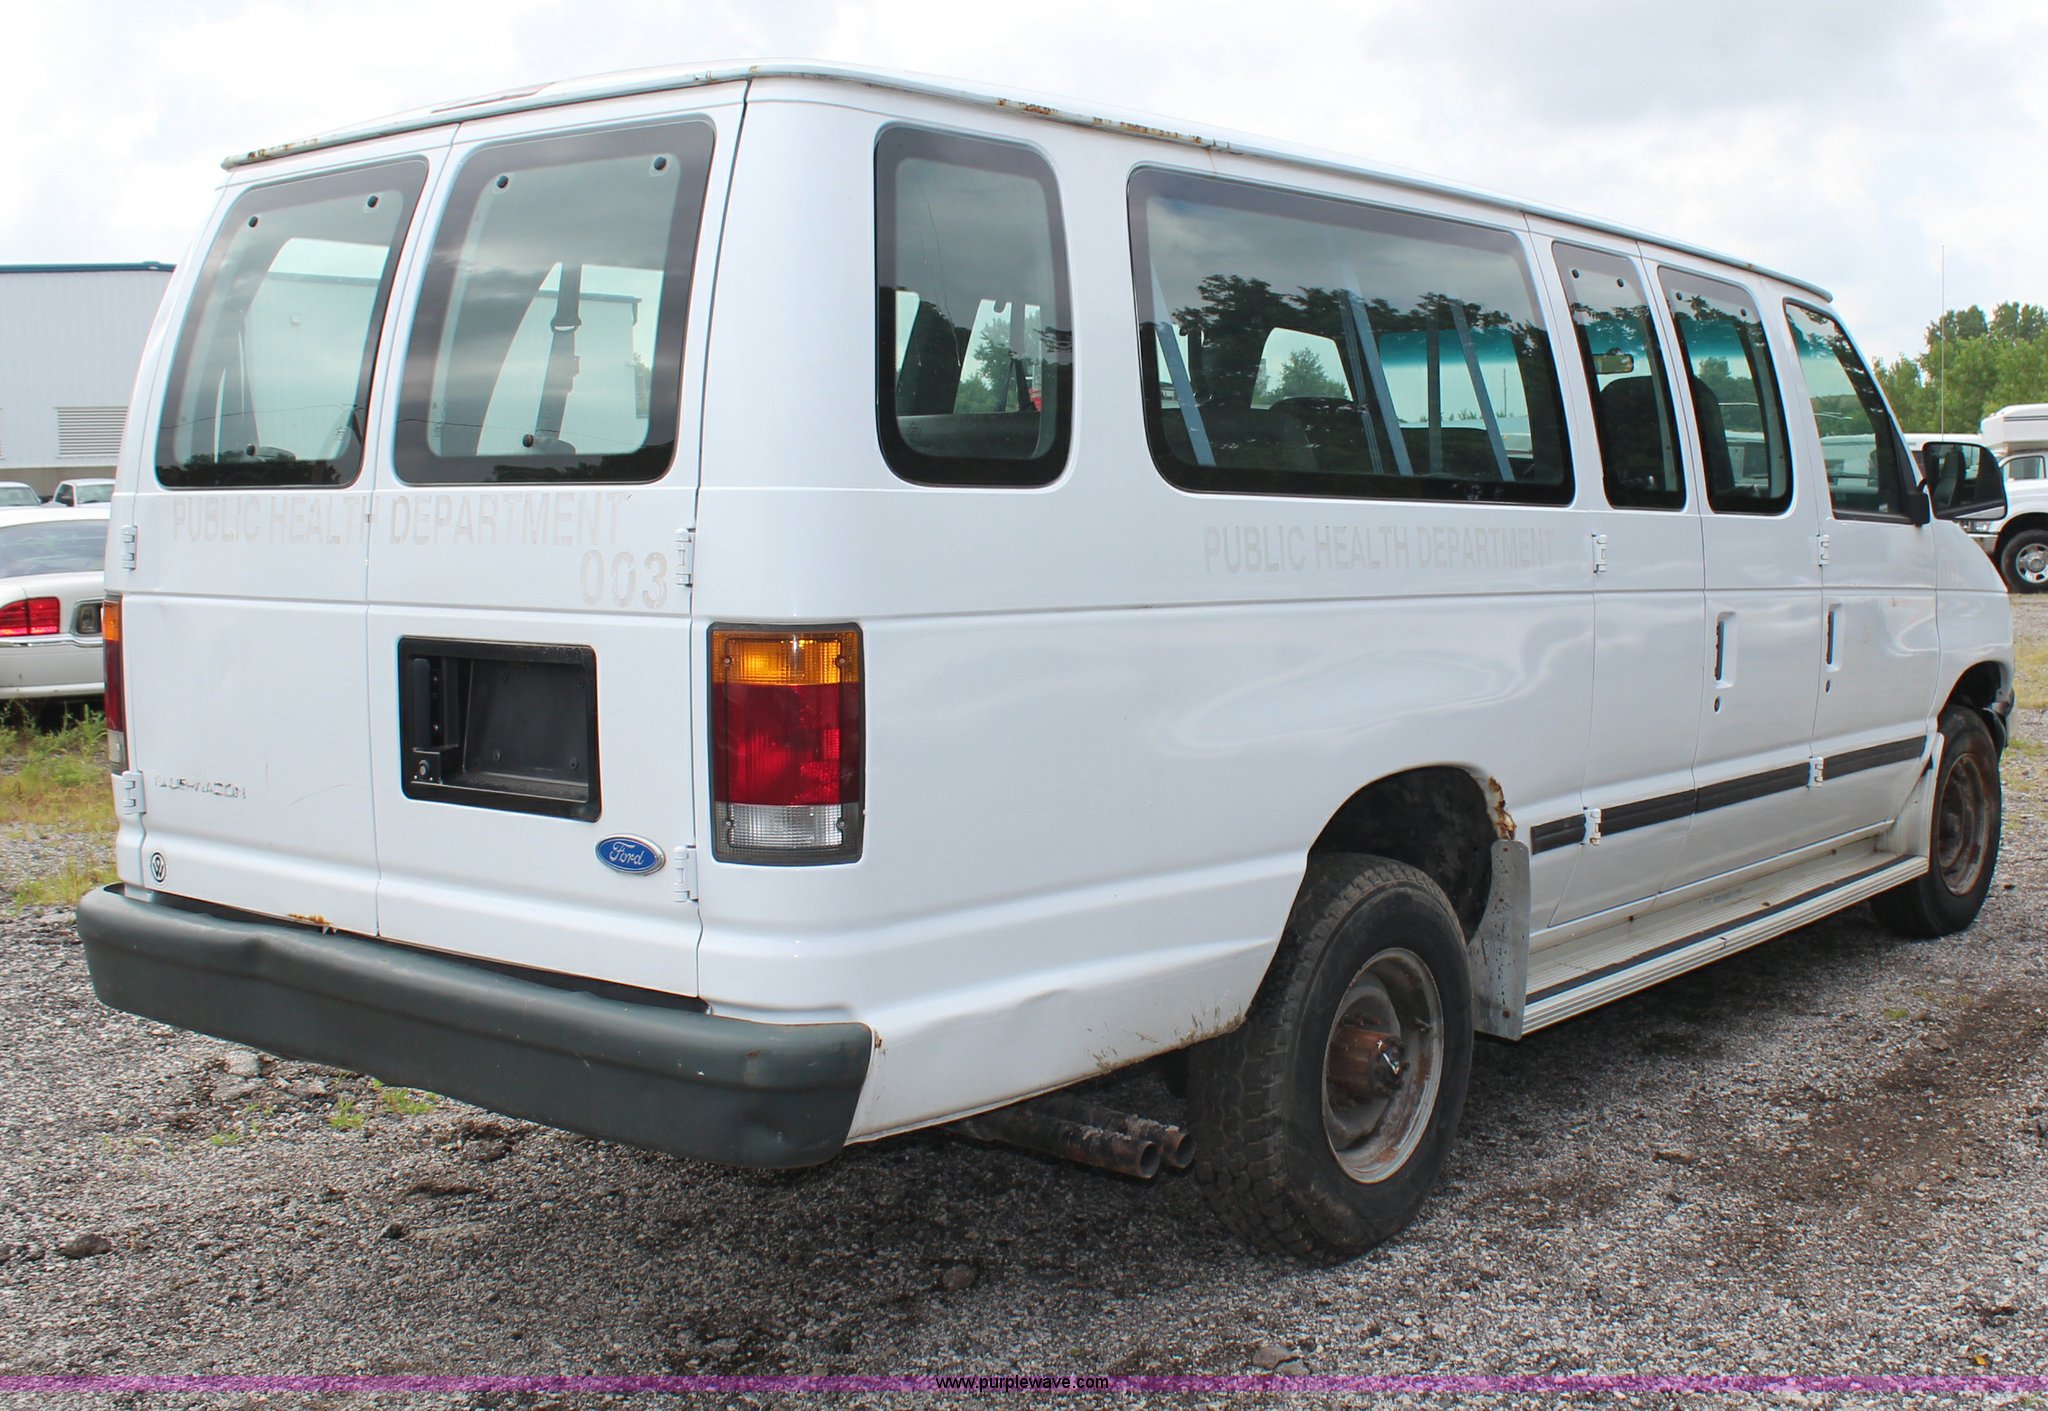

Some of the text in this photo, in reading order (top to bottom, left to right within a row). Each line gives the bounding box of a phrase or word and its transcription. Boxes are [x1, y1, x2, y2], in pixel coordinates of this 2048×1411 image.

[173, 492, 628, 545] PUBLIC HEALTH DEPARTMENT
[1203, 524, 1554, 574] PUBLIC HEALTH DEPARTMENT
[580, 549, 668, 609] 003
[609, 841, 645, 866] Ford
